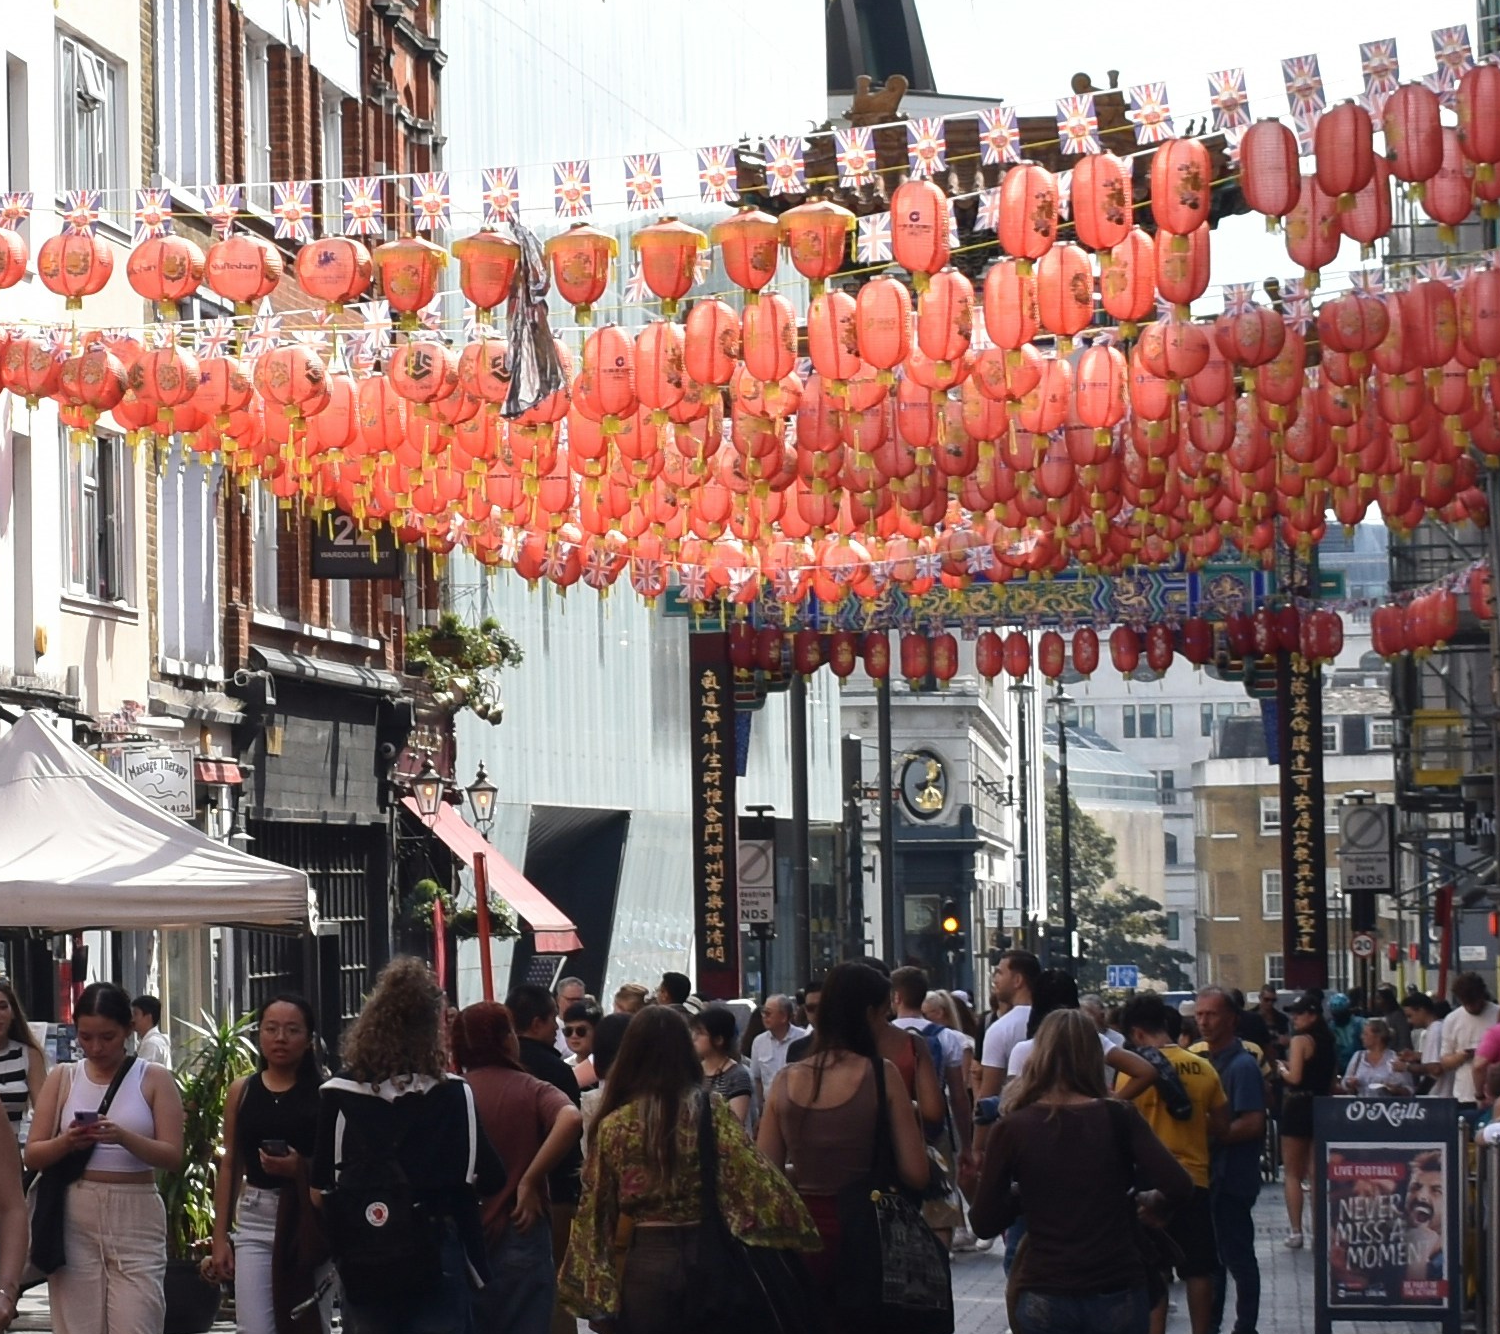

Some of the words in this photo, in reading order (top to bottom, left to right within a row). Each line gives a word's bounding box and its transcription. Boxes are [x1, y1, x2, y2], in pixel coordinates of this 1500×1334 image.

[127, 761, 158, 781] Massage
[160, 759, 189, 781] Therapy
[1347, 875, 1384, 886] ENDS
[739, 890, 771, 898] destrian
[741, 909, 768, 920] NDS
[1355, 940, 1372, 951] 20
[1334, 1165, 1356, 1176] LIVE
[1359, 1164, 1398, 1176] FOOTBALL
[1339, 1193, 1403, 1223] NEVER
[1335, 1220, 1388, 1251] MISS
[1389, 1217, 1405, 1245] A
